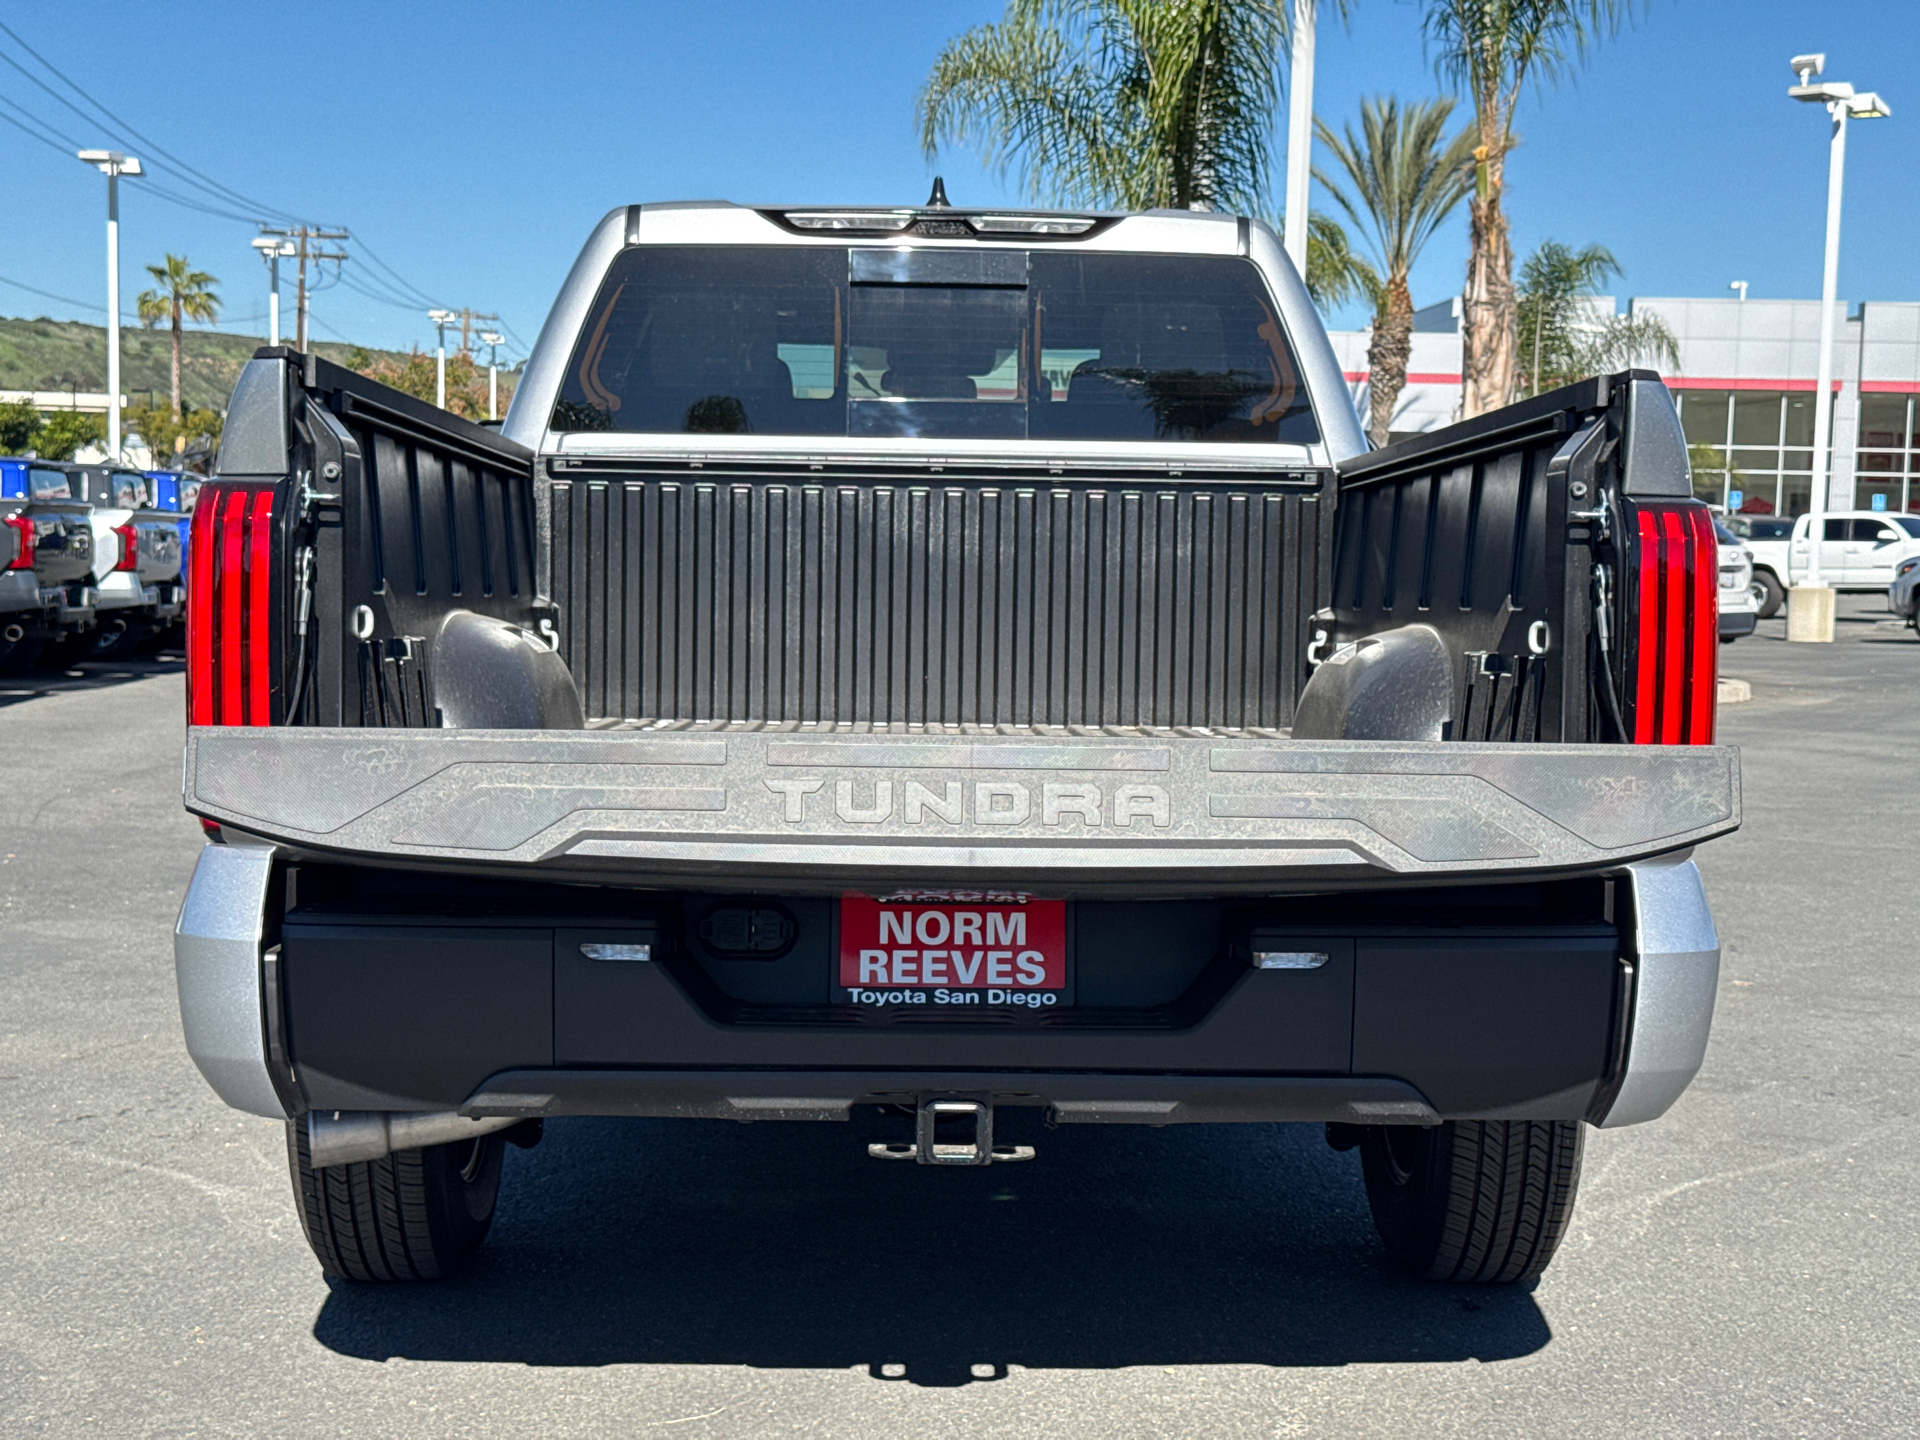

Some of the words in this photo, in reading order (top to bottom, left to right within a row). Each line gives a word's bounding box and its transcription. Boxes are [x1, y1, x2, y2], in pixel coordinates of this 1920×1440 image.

[763, 780, 1170, 827] TUNDRA
[879, 911, 1026, 945] NORM
[859, 950, 1046, 985] REEVES
[848, 988, 926, 1006] Toyota
[933, 988, 979, 1005] San
[987, 989, 1057, 1008] Diego
